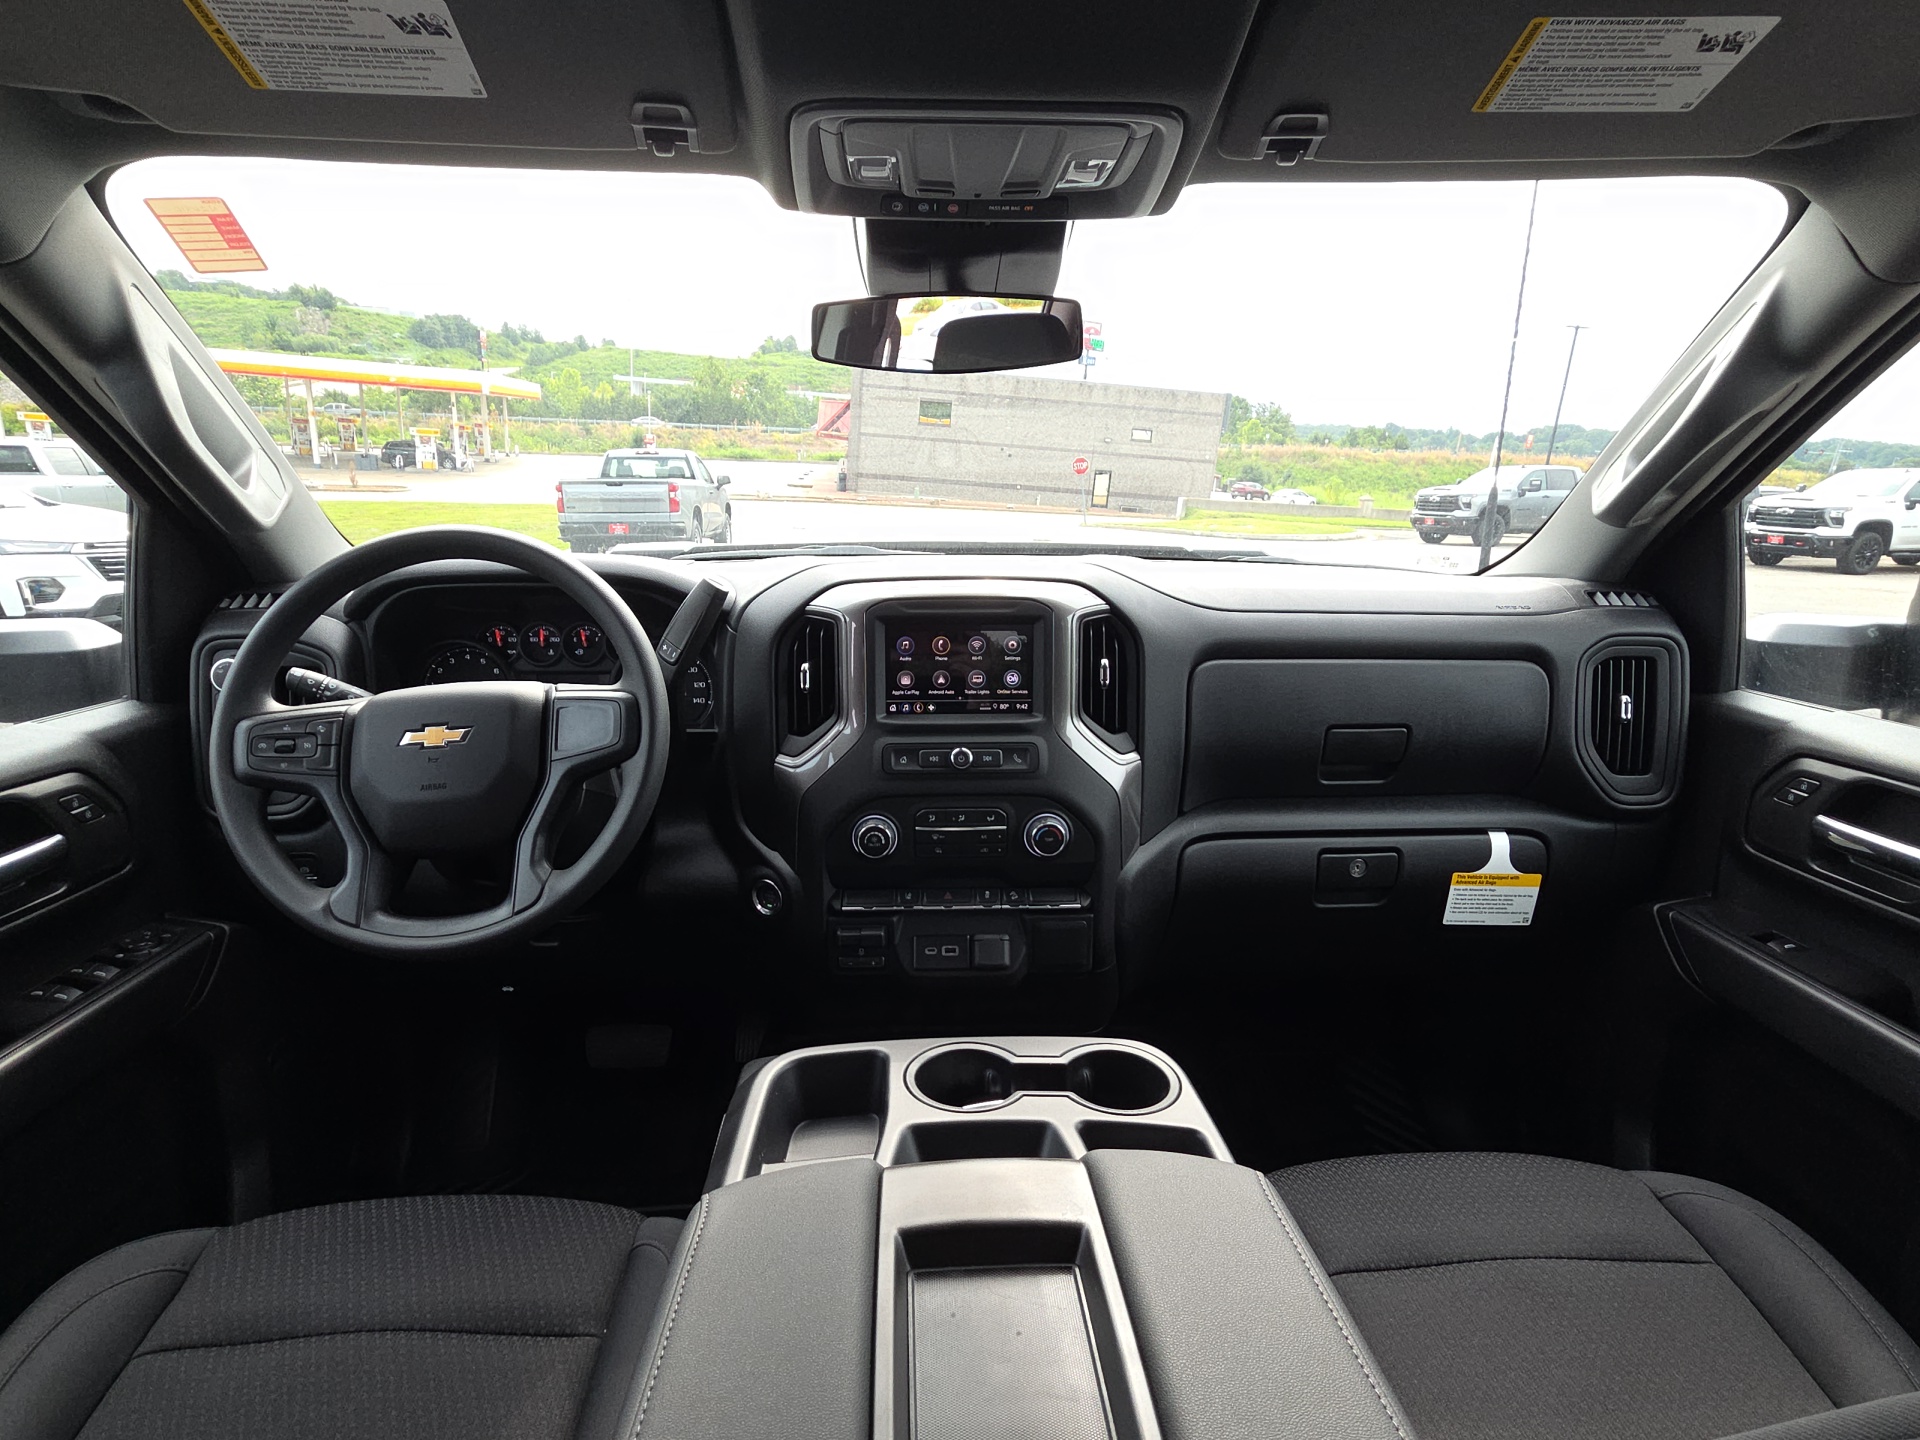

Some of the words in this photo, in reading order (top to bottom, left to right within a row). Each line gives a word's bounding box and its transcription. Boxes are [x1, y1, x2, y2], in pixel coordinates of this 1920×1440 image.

[237, 40, 263, 48] MÊME
[264, 41, 287, 49] AVEC
[328, 44, 380, 53] GONFLABLES
[380, 47, 436, 55] INTELLIGENTS
[1074, 462, 1088, 470] STOP
[420, 783, 447, 791] AIRBAG
